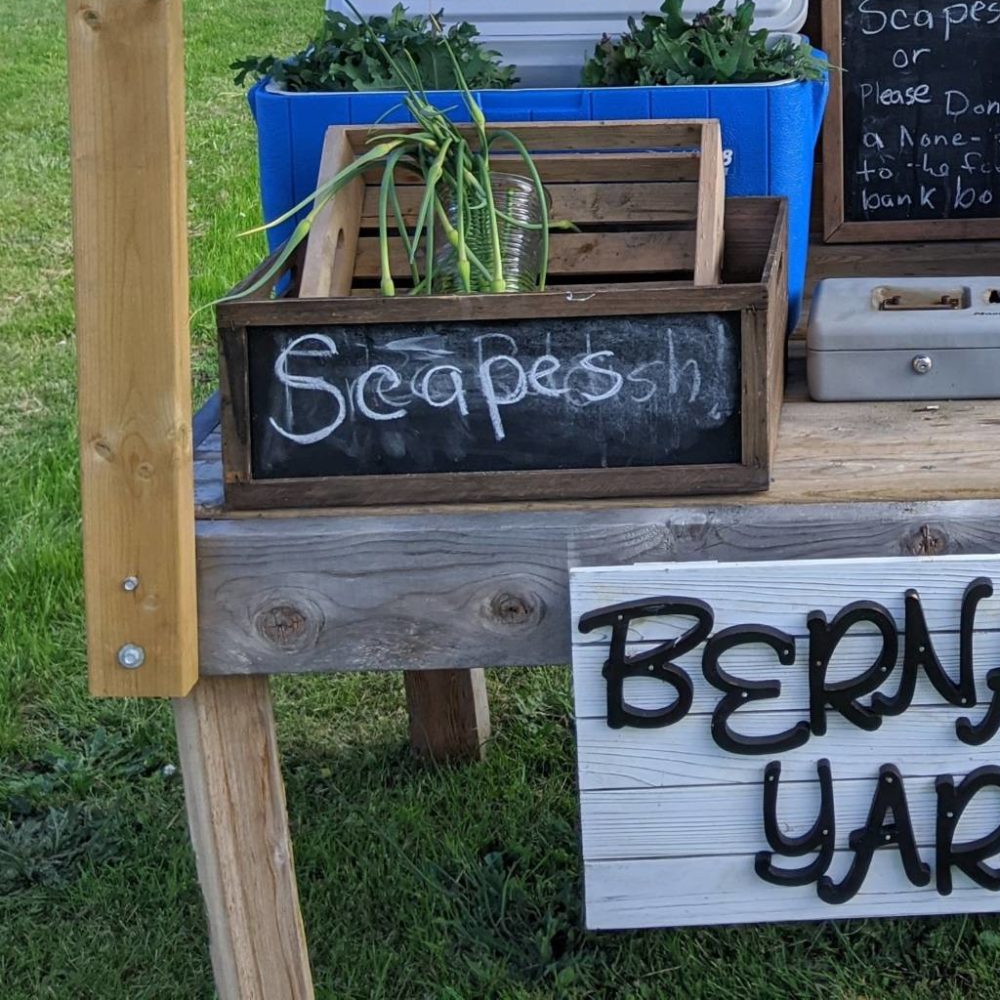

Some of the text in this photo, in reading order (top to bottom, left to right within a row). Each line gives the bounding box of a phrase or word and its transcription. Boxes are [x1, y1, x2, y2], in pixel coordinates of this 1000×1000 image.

[892, 48, 931, 68] or
[860, 83, 931, 107] Please
[863, 131, 885, 149] a
[857, 159, 894, 182] to
[861, 184, 937, 210] bank
